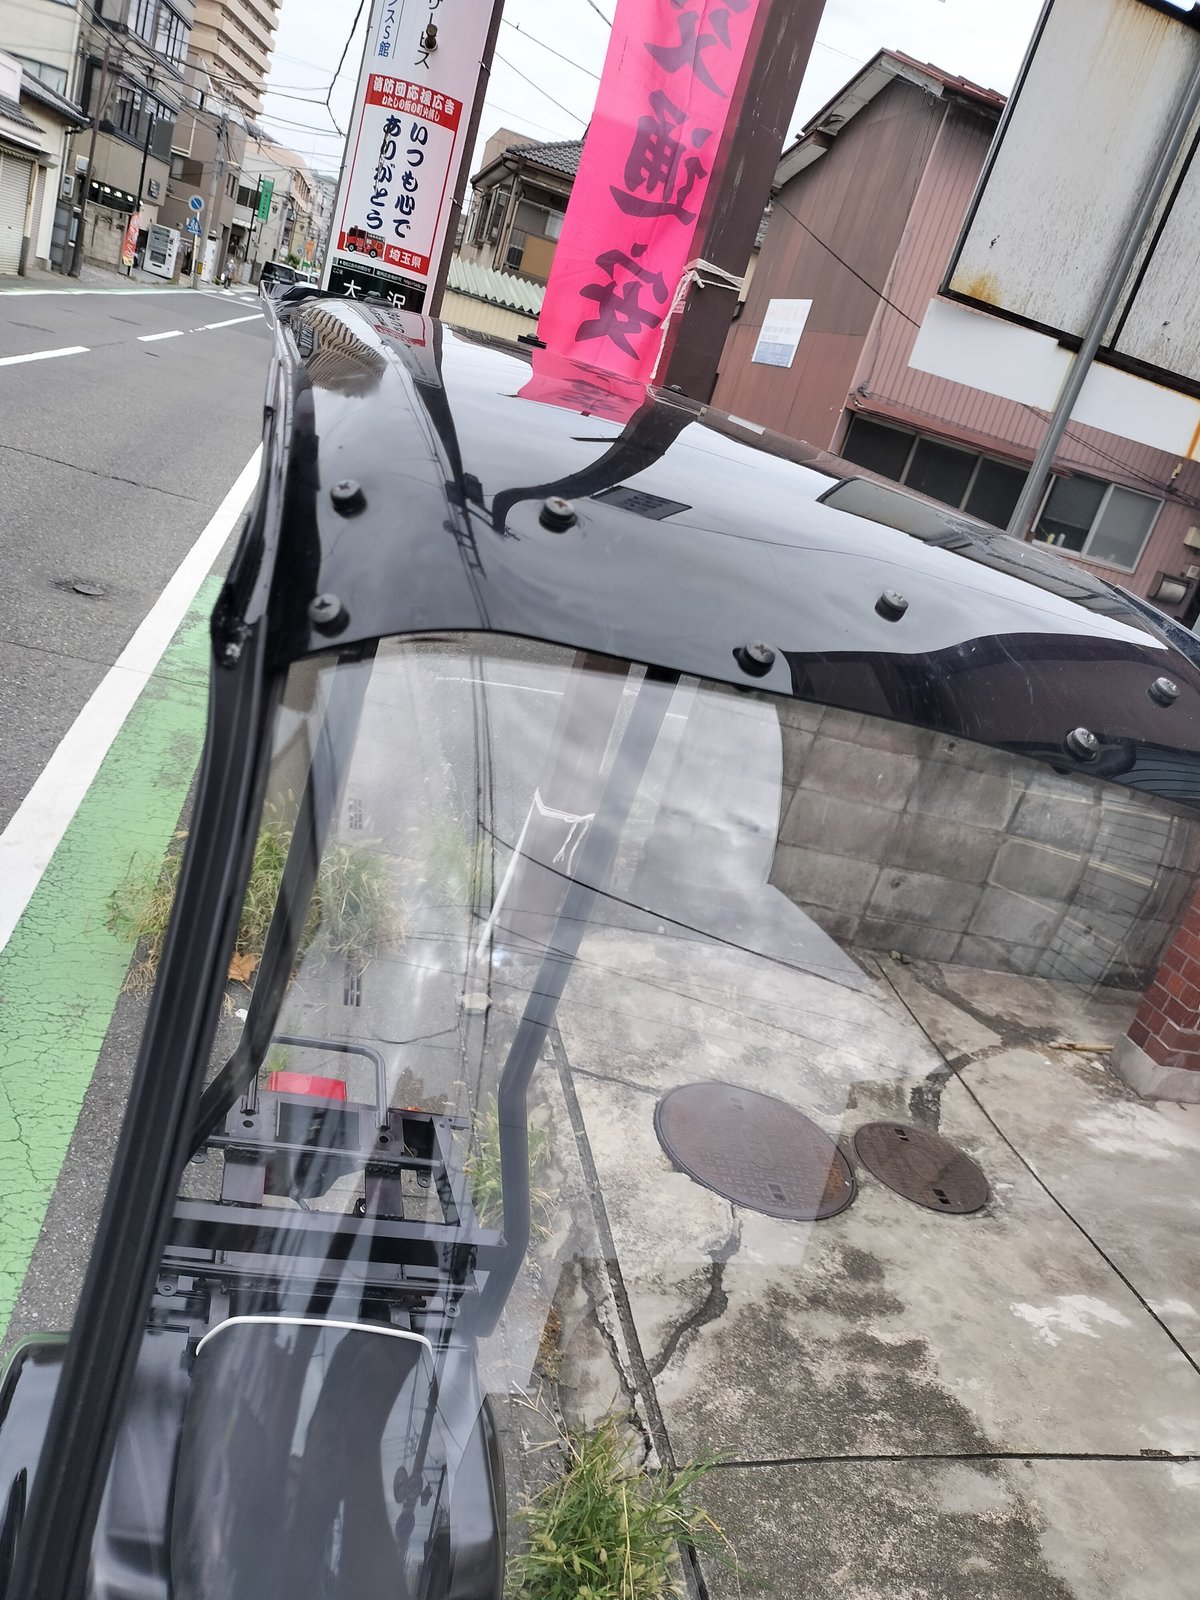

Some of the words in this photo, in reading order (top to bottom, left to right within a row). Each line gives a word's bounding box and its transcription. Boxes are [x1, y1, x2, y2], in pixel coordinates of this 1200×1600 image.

[373, 75, 455, 116] 消防団応援広告
[366, 114, 402, 229] ありがとう
[394, 122, 428, 238] いつも心で
[388, 247, 422, 269] 埼玉県
